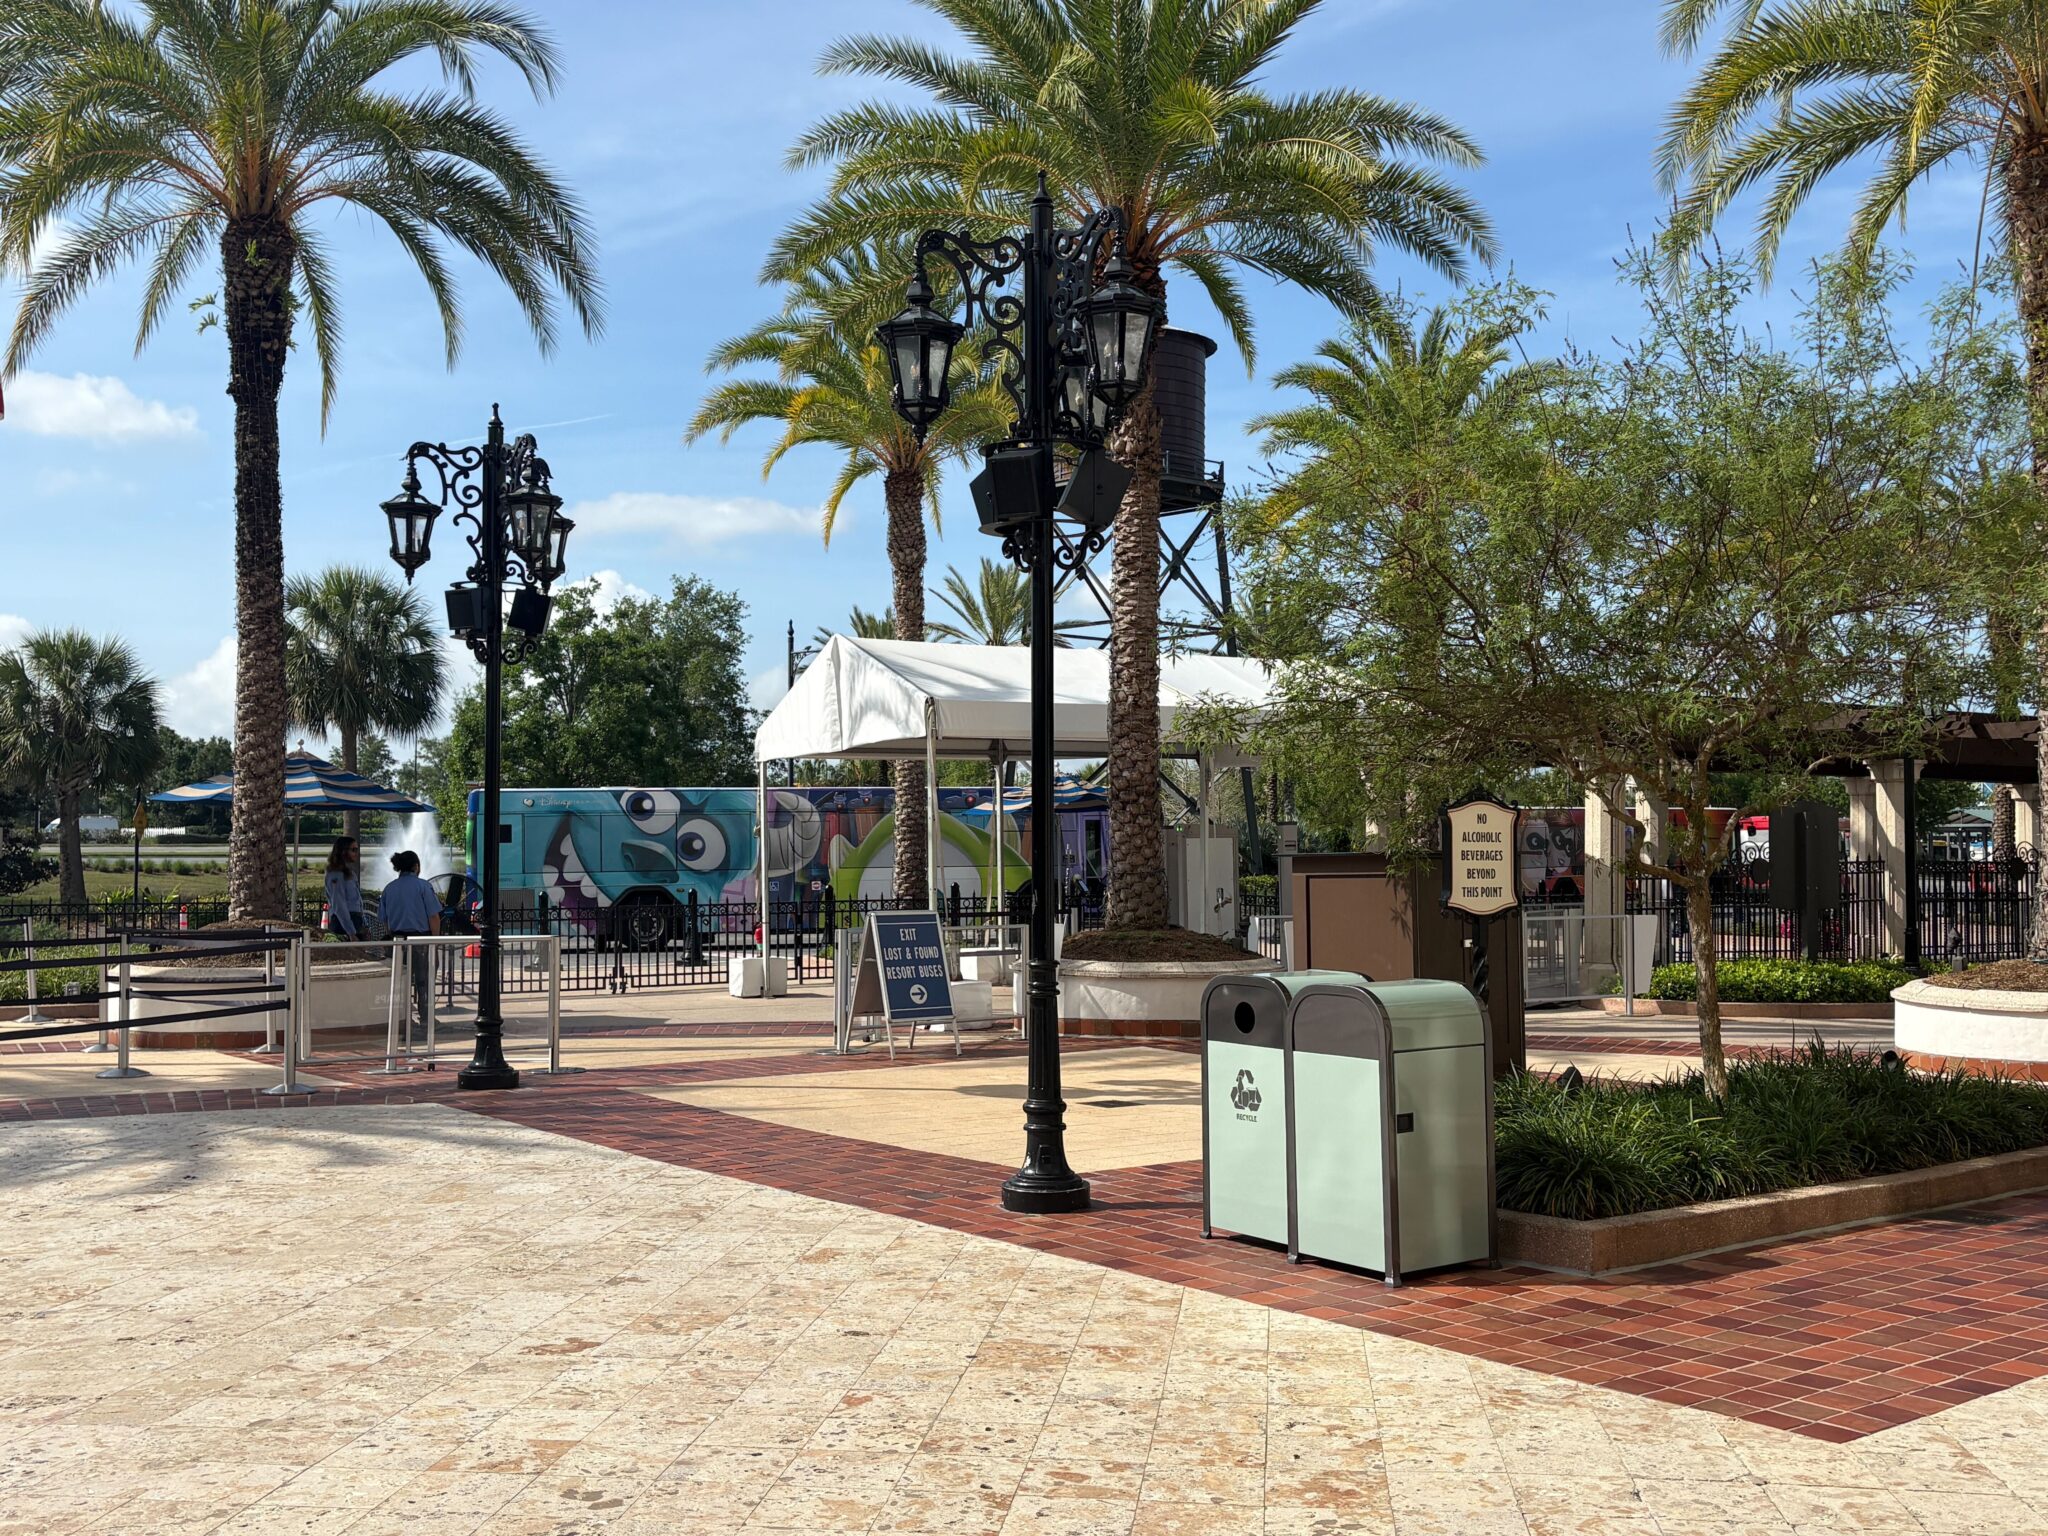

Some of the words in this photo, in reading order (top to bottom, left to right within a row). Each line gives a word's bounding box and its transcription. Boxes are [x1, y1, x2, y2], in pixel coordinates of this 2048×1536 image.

[1476, 813, 1487, 825] NO
[1461, 831, 1502, 843] ALCOHOLIC
[1460, 849, 1503, 862] BEVERAGES
[1466, 868, 1496, 880] BEYOND
[1461, 886, 1479, 898] THIS
[1480, 886, 1503, 898] POINT
[899, 928, 917, 942] EXIT
[883, 947, 902, 961] LOST
[905, 948, 912, 960] &
[914, 945, 939, 960] FOUND
[886, 965, 916, 980] RESORT
[918, 964, 944, 978] BUSES
[1236, 1113, 1258, 1123] RECYCLE
